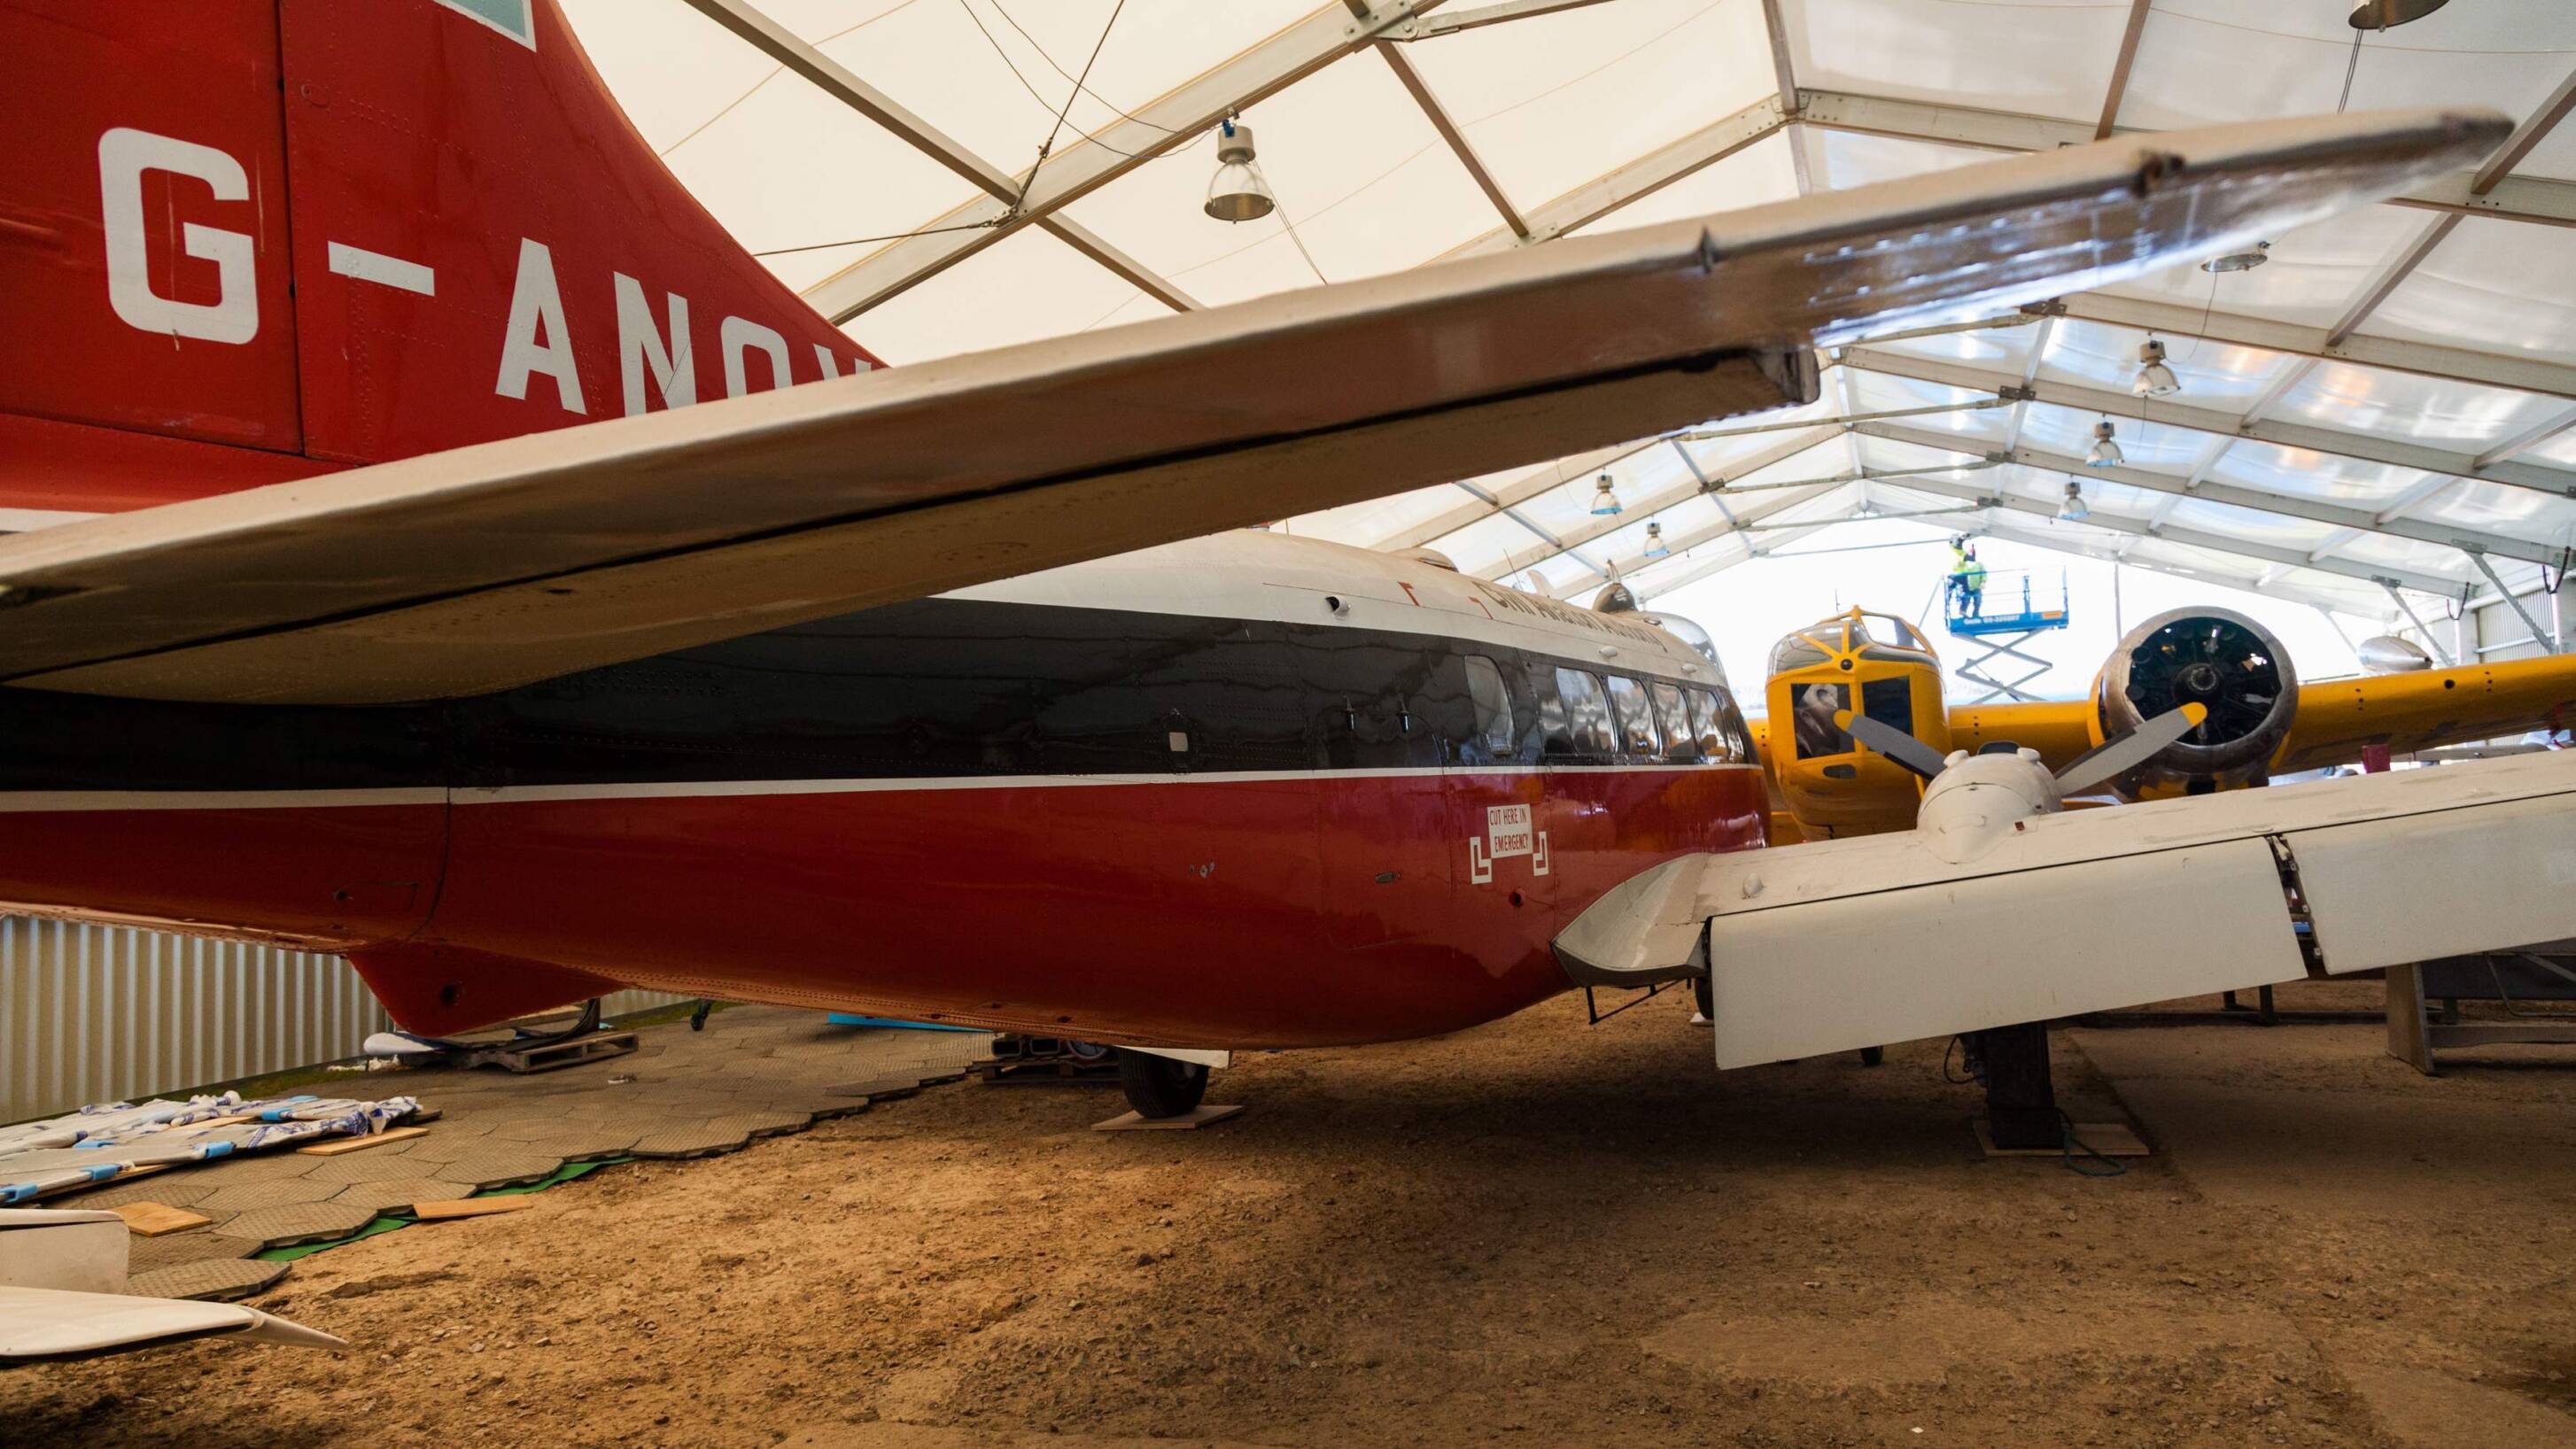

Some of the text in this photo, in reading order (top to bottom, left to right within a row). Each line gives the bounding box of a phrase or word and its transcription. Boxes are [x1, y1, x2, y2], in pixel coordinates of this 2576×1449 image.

[98, 127, 872, 418] G-ANO
[1489, 807, 1527, 825] CUT HERE IN
[1494, 833, 1529, 853] EMERGENCY
